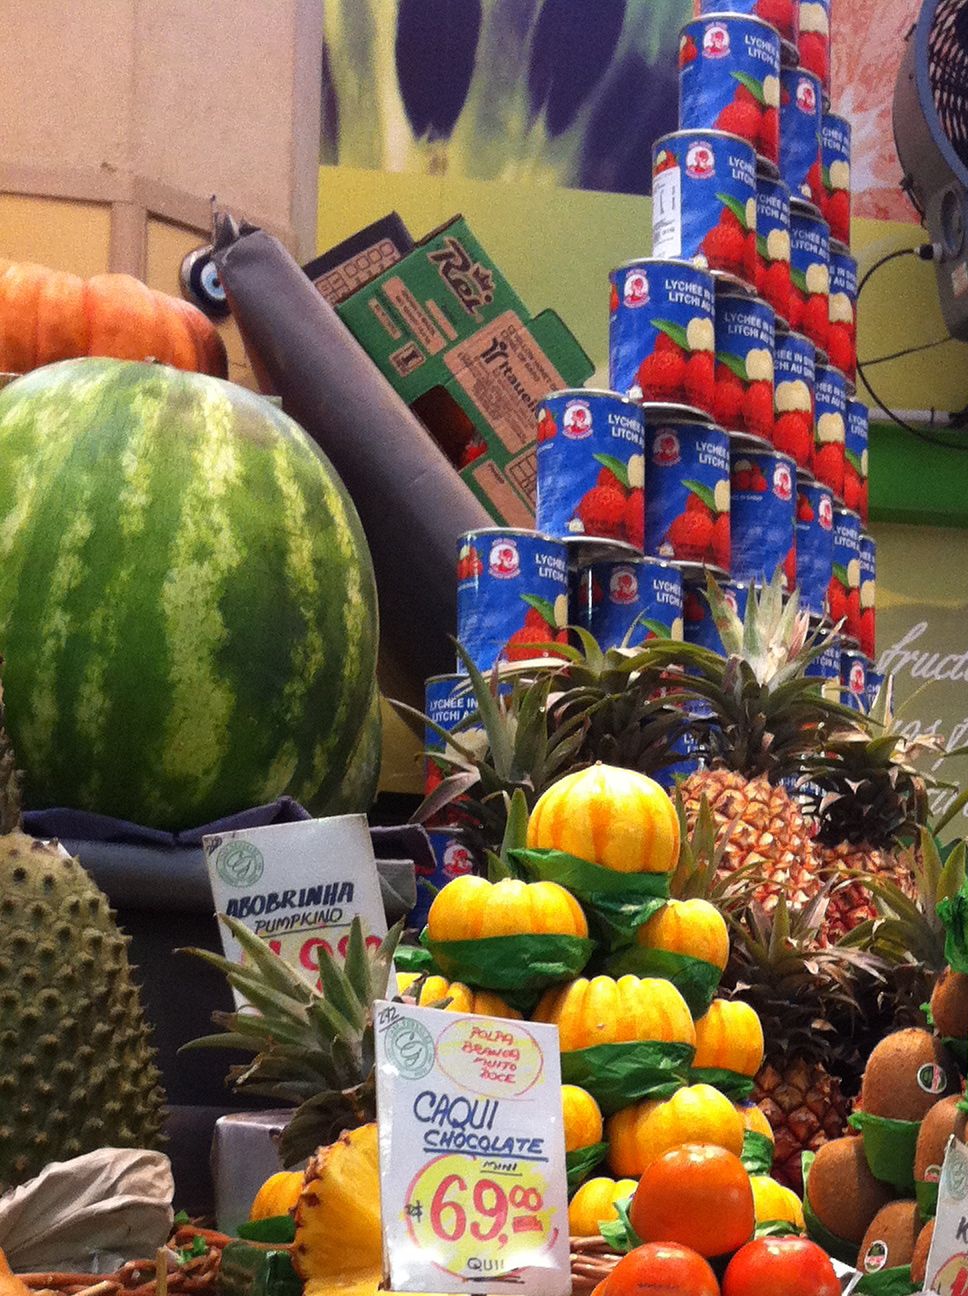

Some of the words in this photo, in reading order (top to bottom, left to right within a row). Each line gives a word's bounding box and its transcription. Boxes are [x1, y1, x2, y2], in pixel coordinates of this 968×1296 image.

[226, 881, 355, 919] ABOBRINHA
[413, 1090, 499, 1130] CAQUI
[424, 1128, 544, 1154] CHOCOLATE
